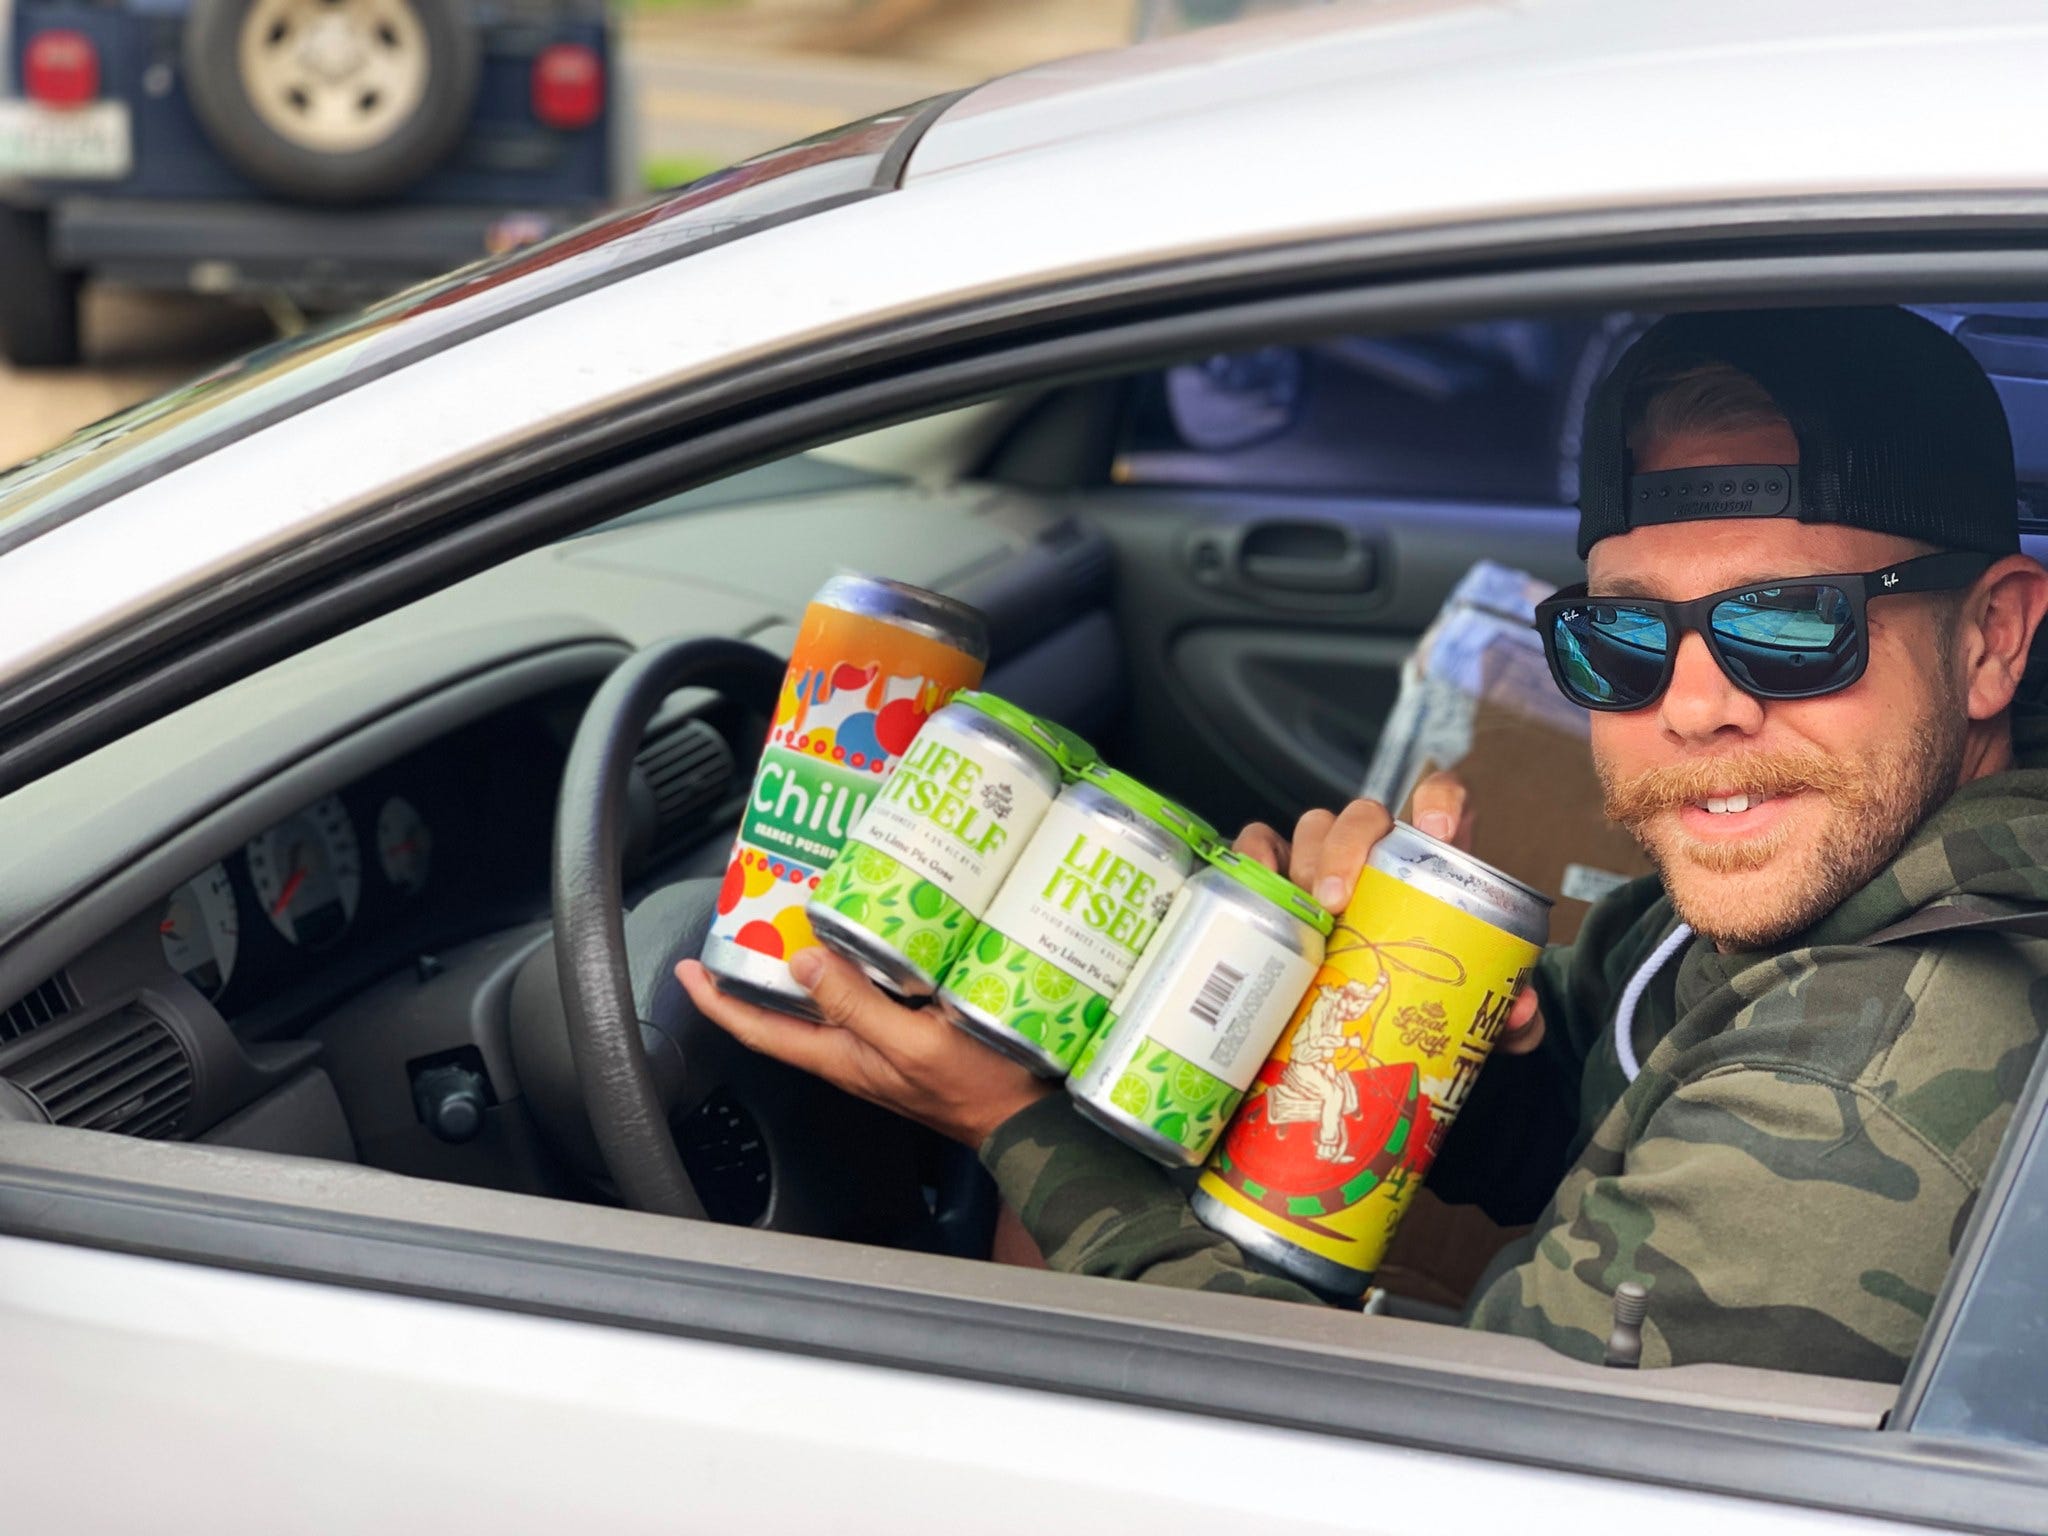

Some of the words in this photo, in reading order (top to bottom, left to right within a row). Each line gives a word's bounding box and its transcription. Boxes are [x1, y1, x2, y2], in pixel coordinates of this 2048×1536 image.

[903, 738, 983, 796] LIFE
[881, 769, 1007, 854] ITSELF
[885, 832, 909, 853] Lime
[911, 847, 928, 863] Pie
[1063, 833, 1157, 908] LIFE
[1041, 866, 1147, 954] ITSEL
[1039, 933, 1059, 954] Key
[1060, 946, 1087, 970] Lime
[1087, 963, 1102, 980] Pie
[1393, 1005, 1448, 1032] Great
